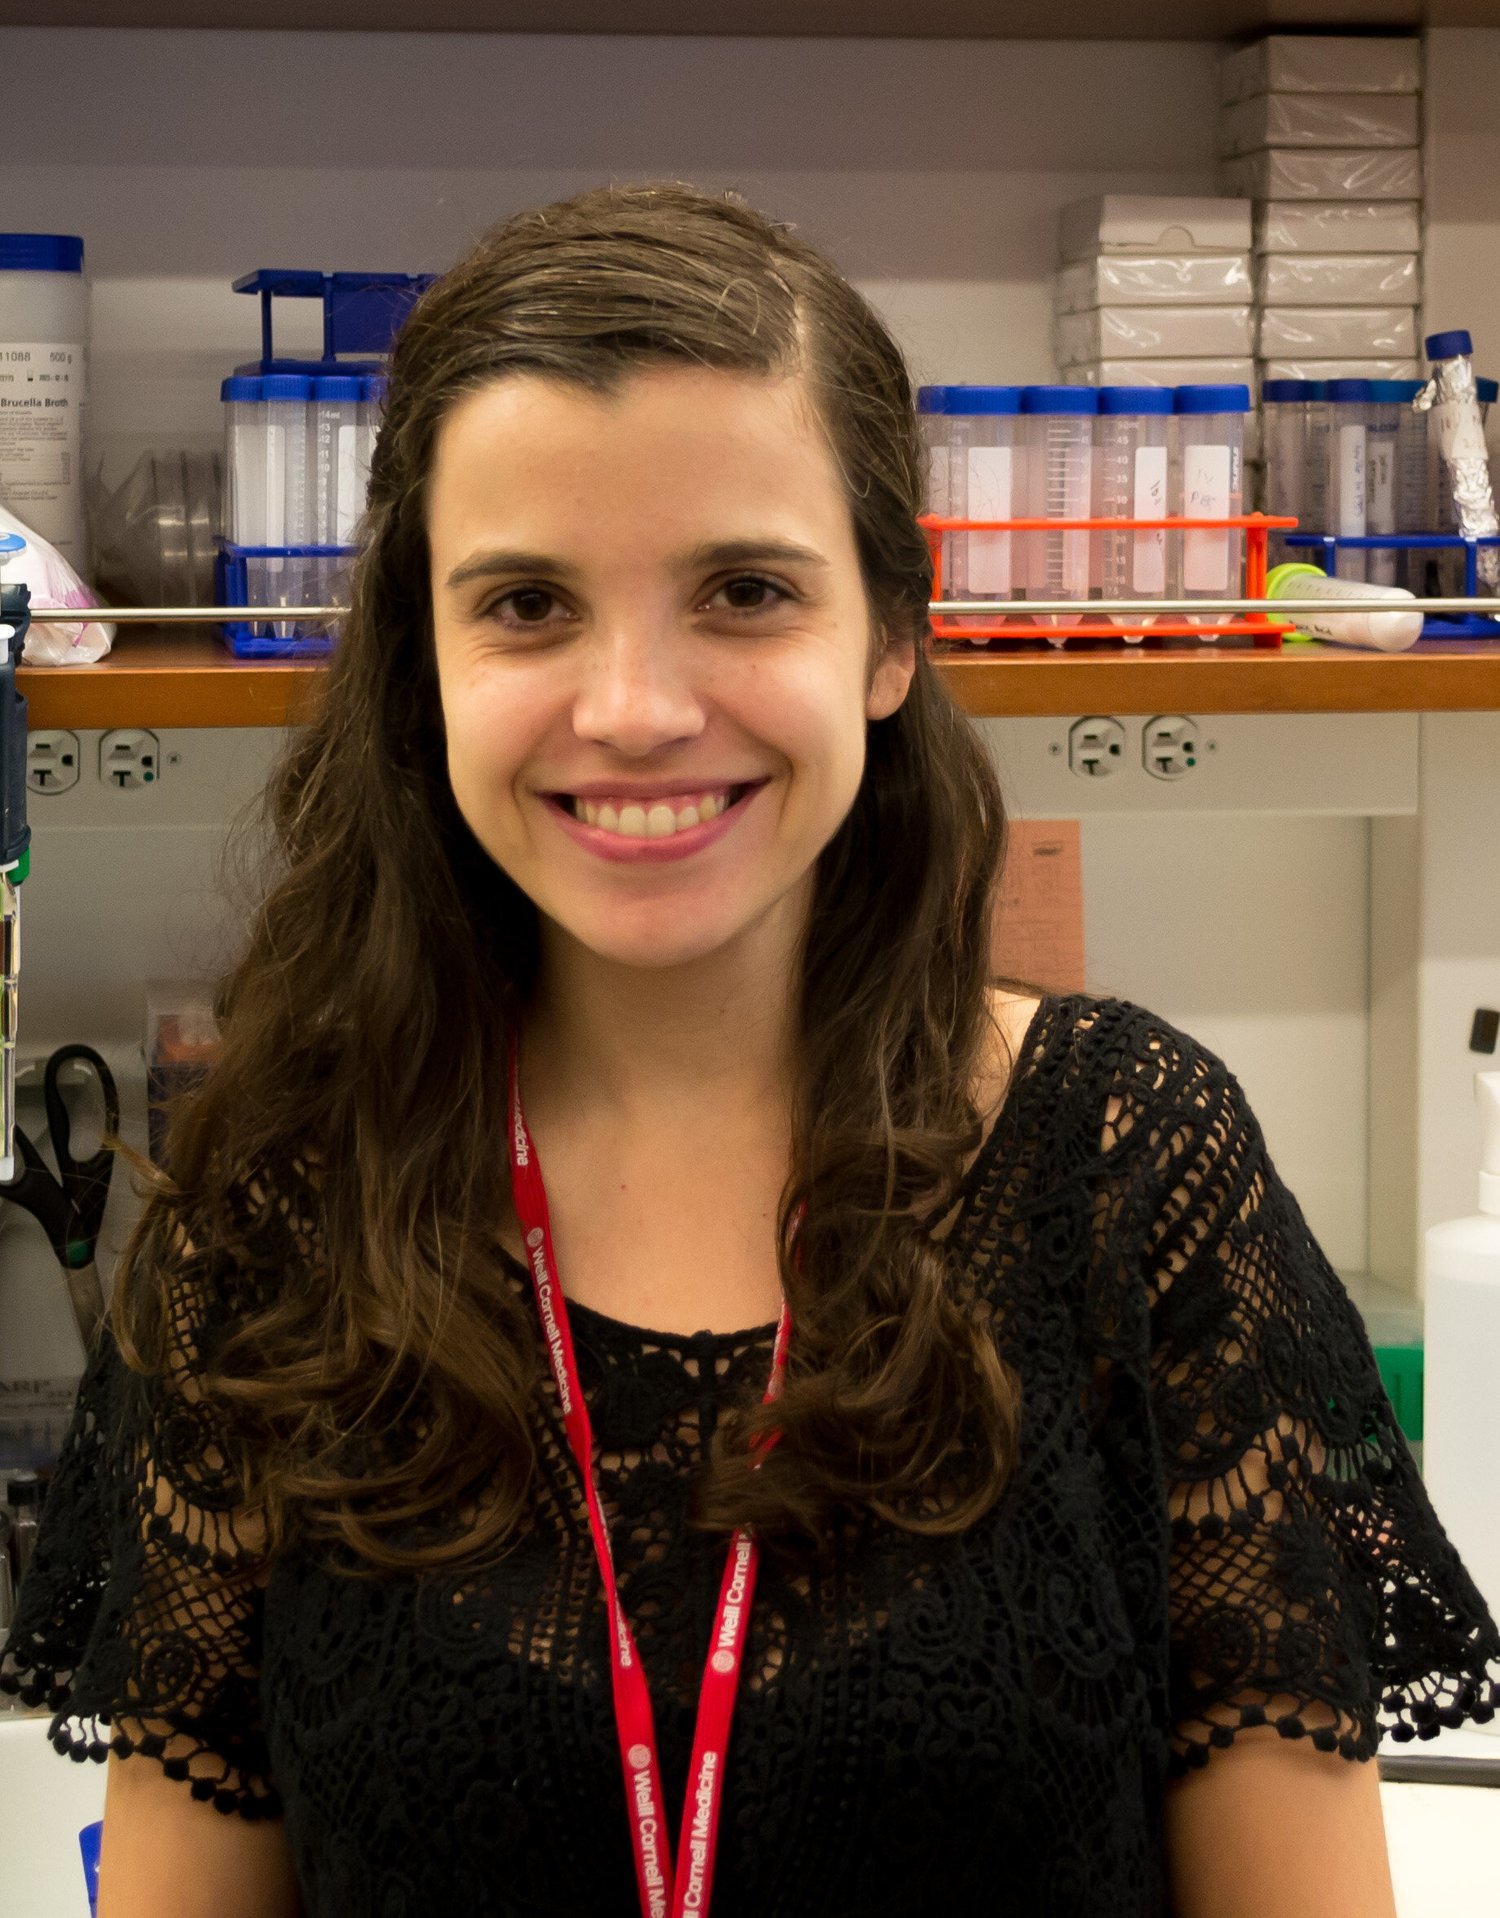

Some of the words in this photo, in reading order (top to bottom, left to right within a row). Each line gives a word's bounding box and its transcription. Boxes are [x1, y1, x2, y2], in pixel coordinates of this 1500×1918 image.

[50, 352, 66, 362] 500
[1, 397, 42, 408] Brucella
[45, 397, 69, 408] Broth
[533, 1246, 549, 1286] Weill
[539, 1284, 561, 1343] Cornell
[551, 1339, 573, 1416] Medicine
[726, 1542, 752, 1604] Cornell
[718, 1605, 741, 1648] Weill
[634, 1770, 655, 1817] Weill
[691, 1751, 717, 1839] Medicine
[639, 1818, 664, 1888] Cornell
[684, 1839, 707, 1908] Cornell
